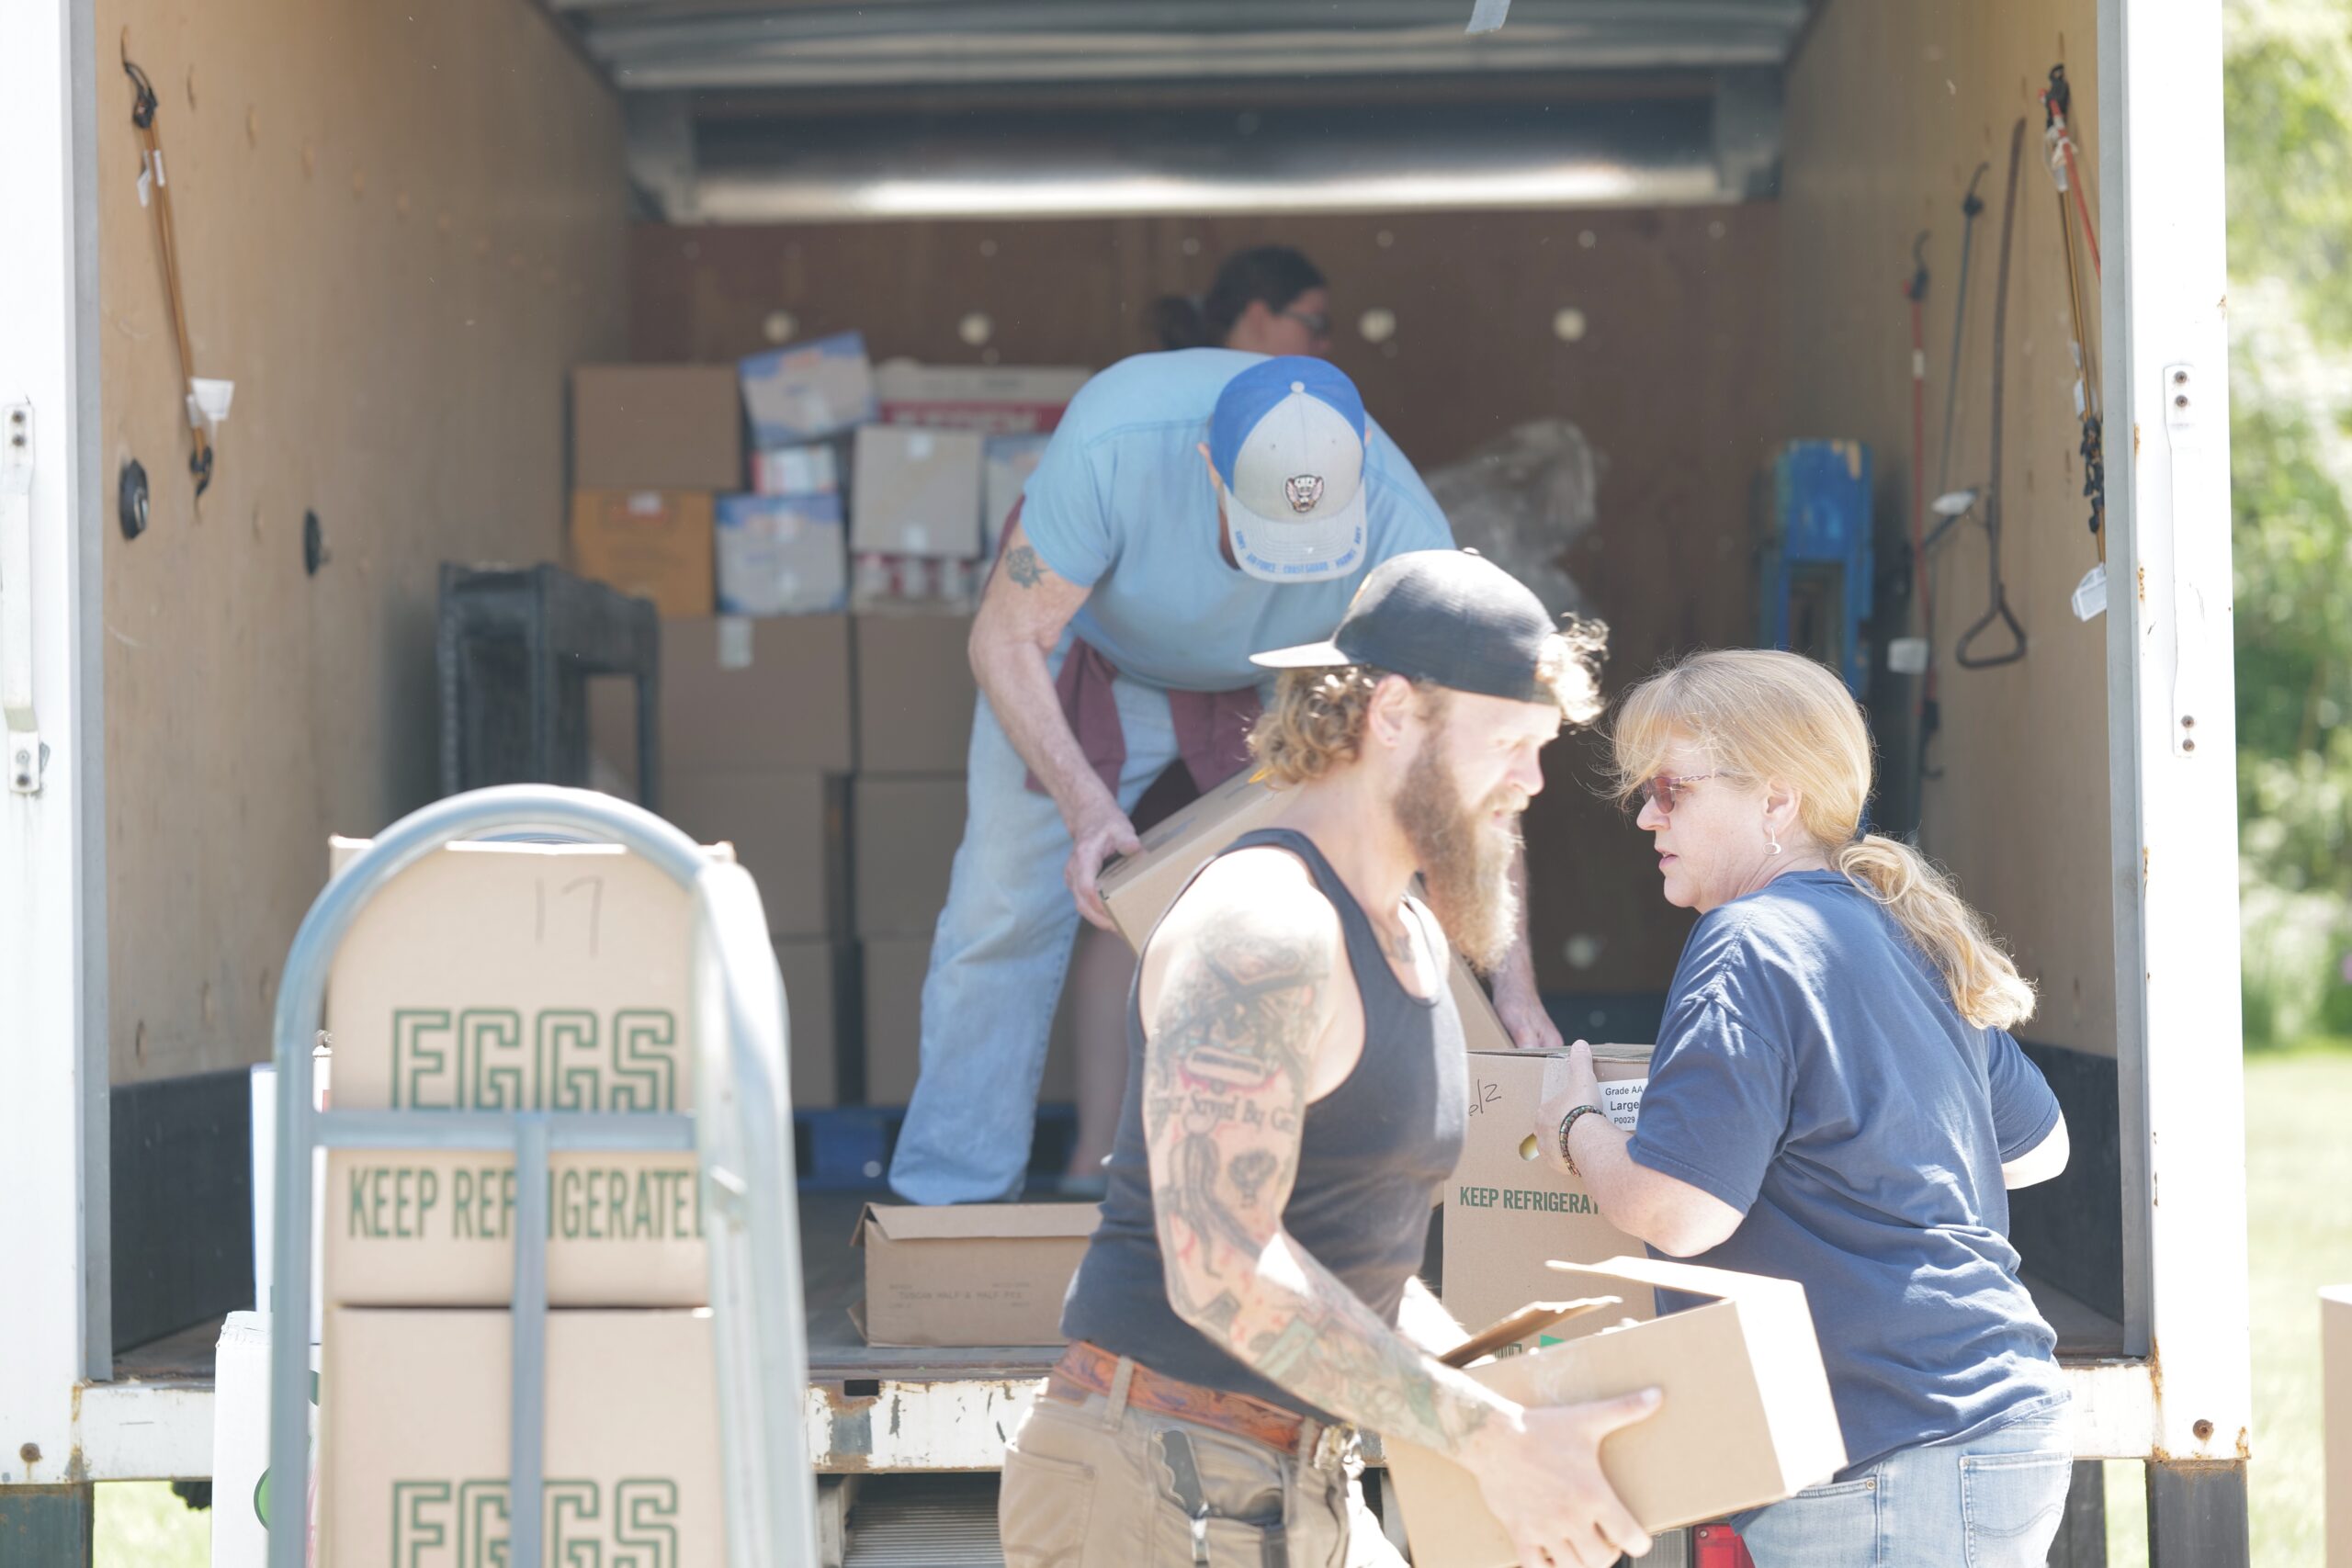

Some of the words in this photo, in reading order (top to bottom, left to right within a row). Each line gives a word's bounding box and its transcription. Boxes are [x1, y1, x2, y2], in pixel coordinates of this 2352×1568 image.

[390, 1008, 677, 1111] EGGS
[1605, 1087, 1630, 1096] Grade
[1631, 1085, 1644, 1094] AA
[1610, 1100, 1639, 1112] Large
[1613, 1116, 1635, 1124] P0029
[348, 1168, 439, 1239] KEEP
[453, 1168, 704, 1239] REFIGERATE
[1460, 1186, 1499, 1208] KEEP
[937, 1291, 960, 1300] HALF
[977, 1291, 1000, 1300] HALF
[391, 1479, 678, 1568] EGGS
